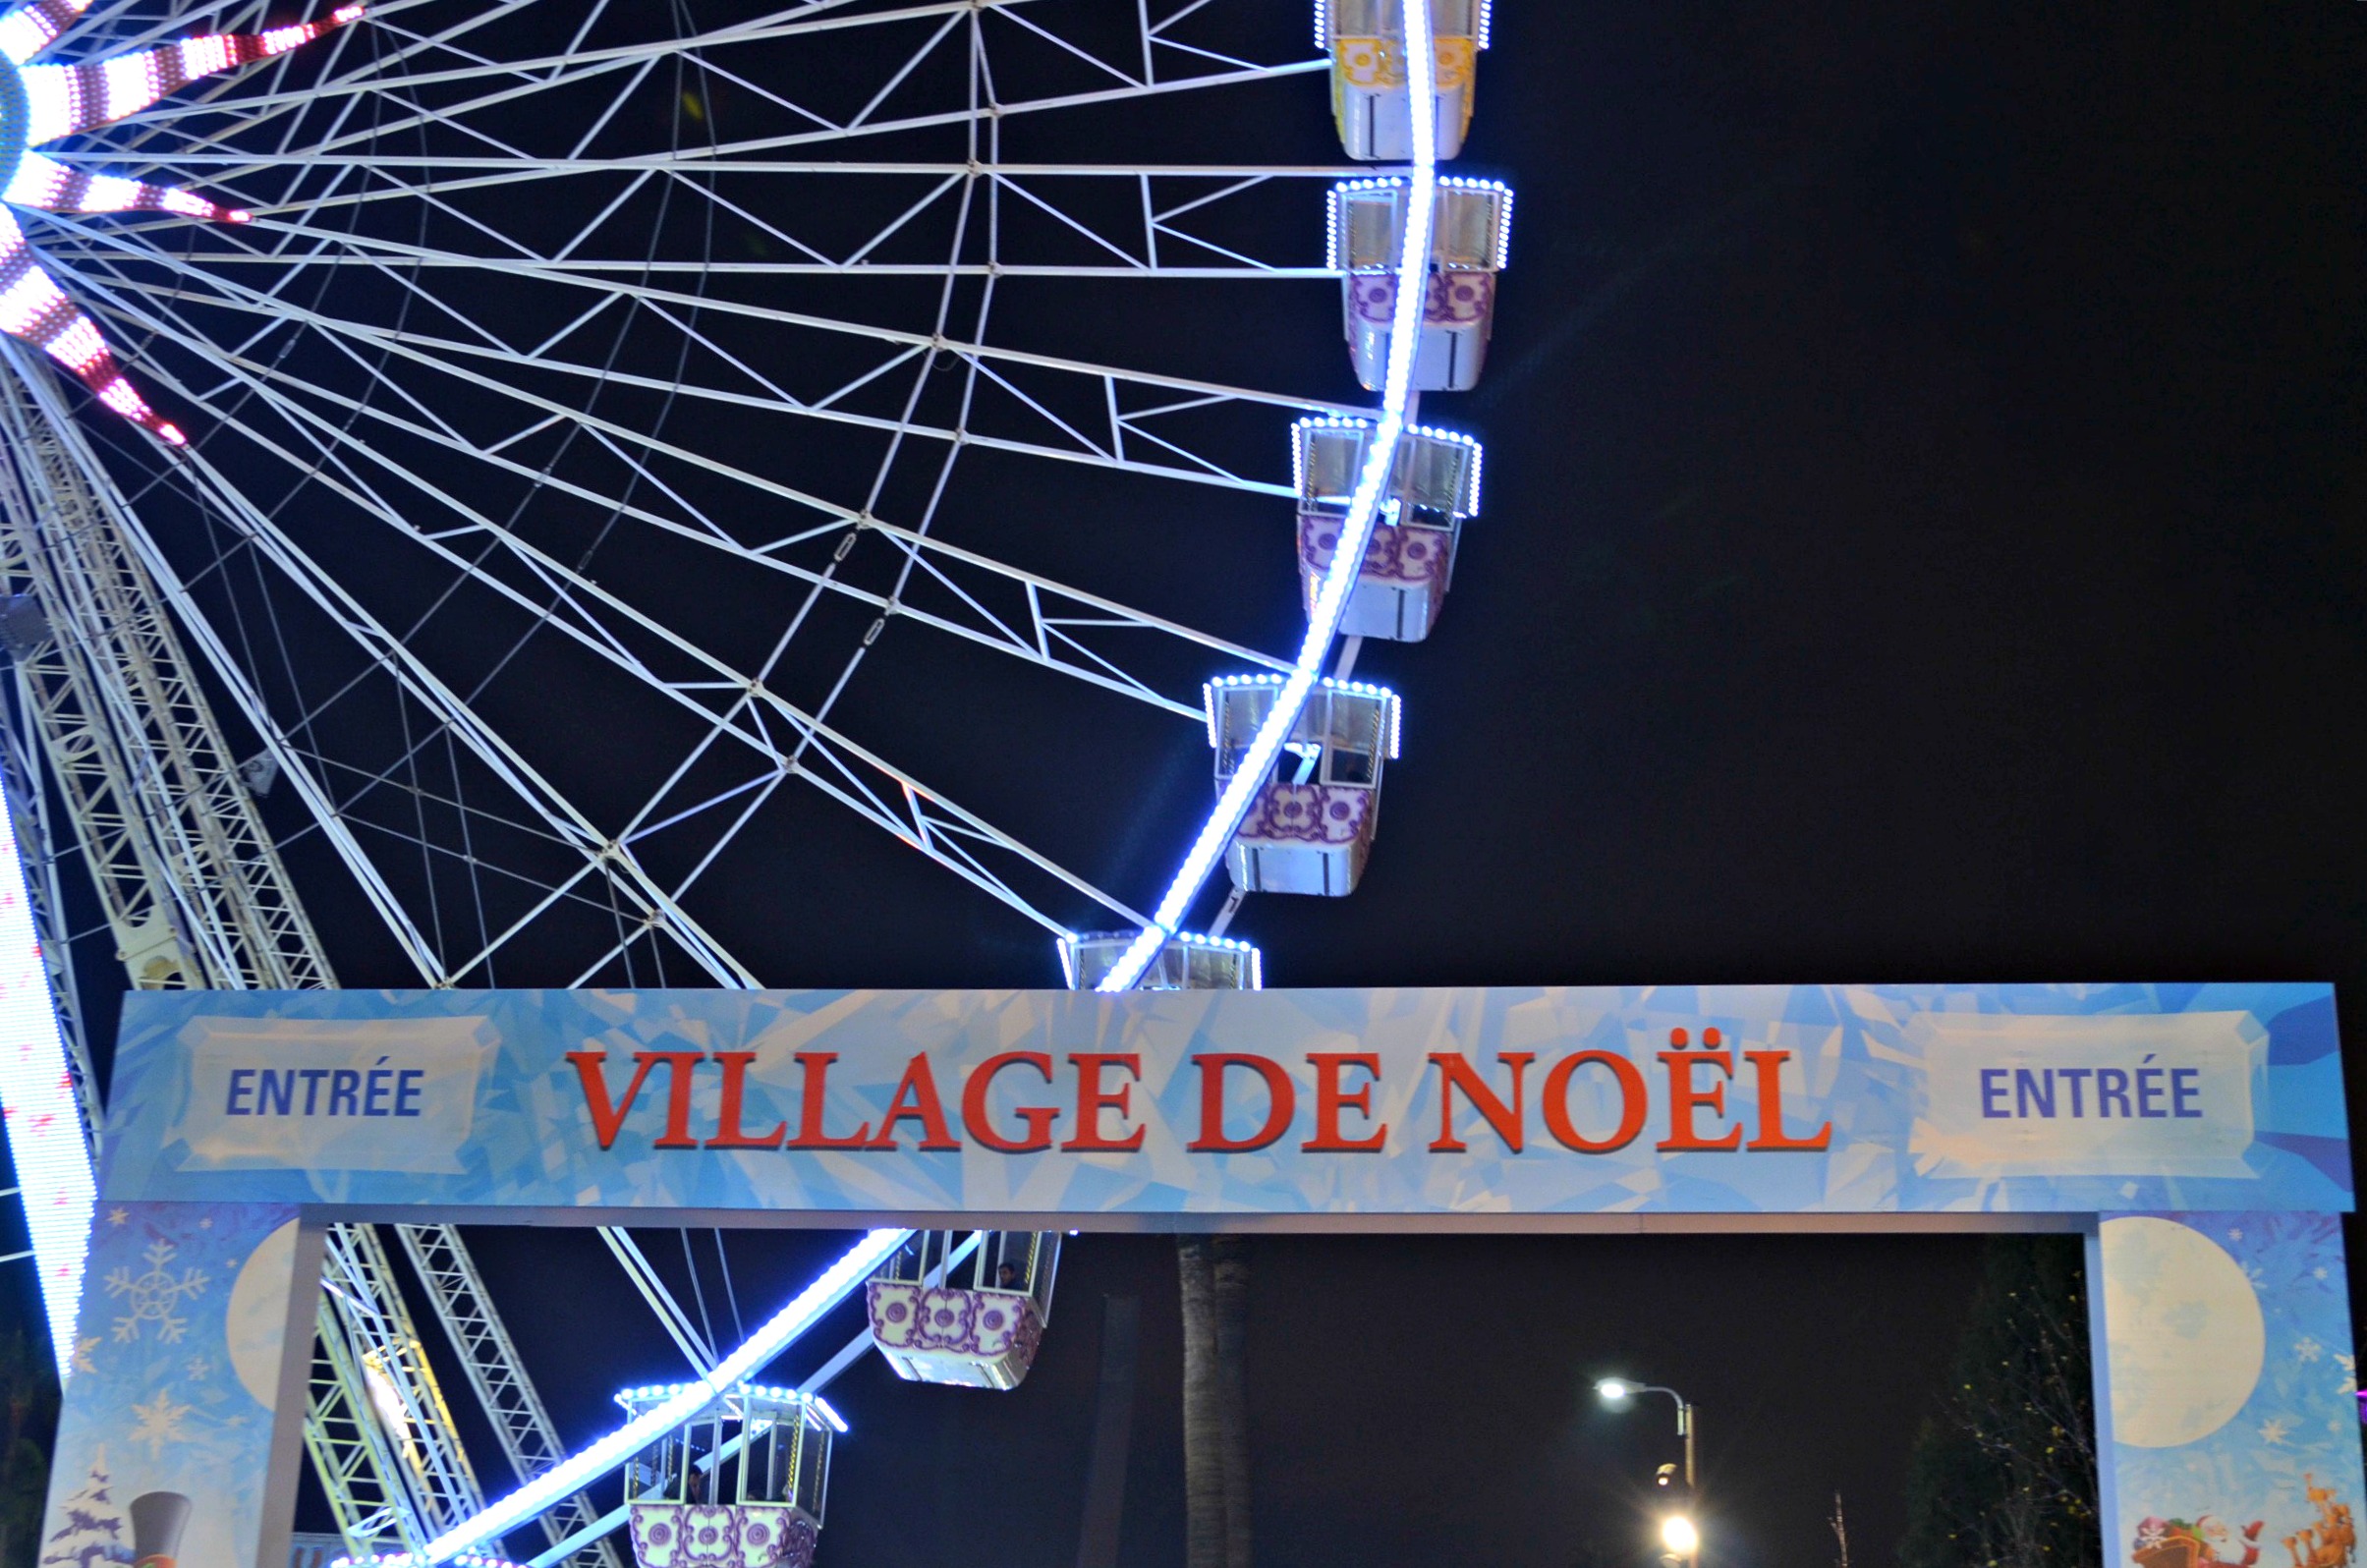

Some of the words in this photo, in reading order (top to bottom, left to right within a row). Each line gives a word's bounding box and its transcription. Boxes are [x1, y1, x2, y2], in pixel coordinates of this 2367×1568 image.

[225, 1055, 426, 1118] ENTRÉE
[566, 1051, 1147, 1150] VILLAGE
[1188, 1052, 1388, 1150] DE
[1429, 1027, 1832, 1151] NOËL
[1980, 1053, 2204, 1119] ENTRÉE
